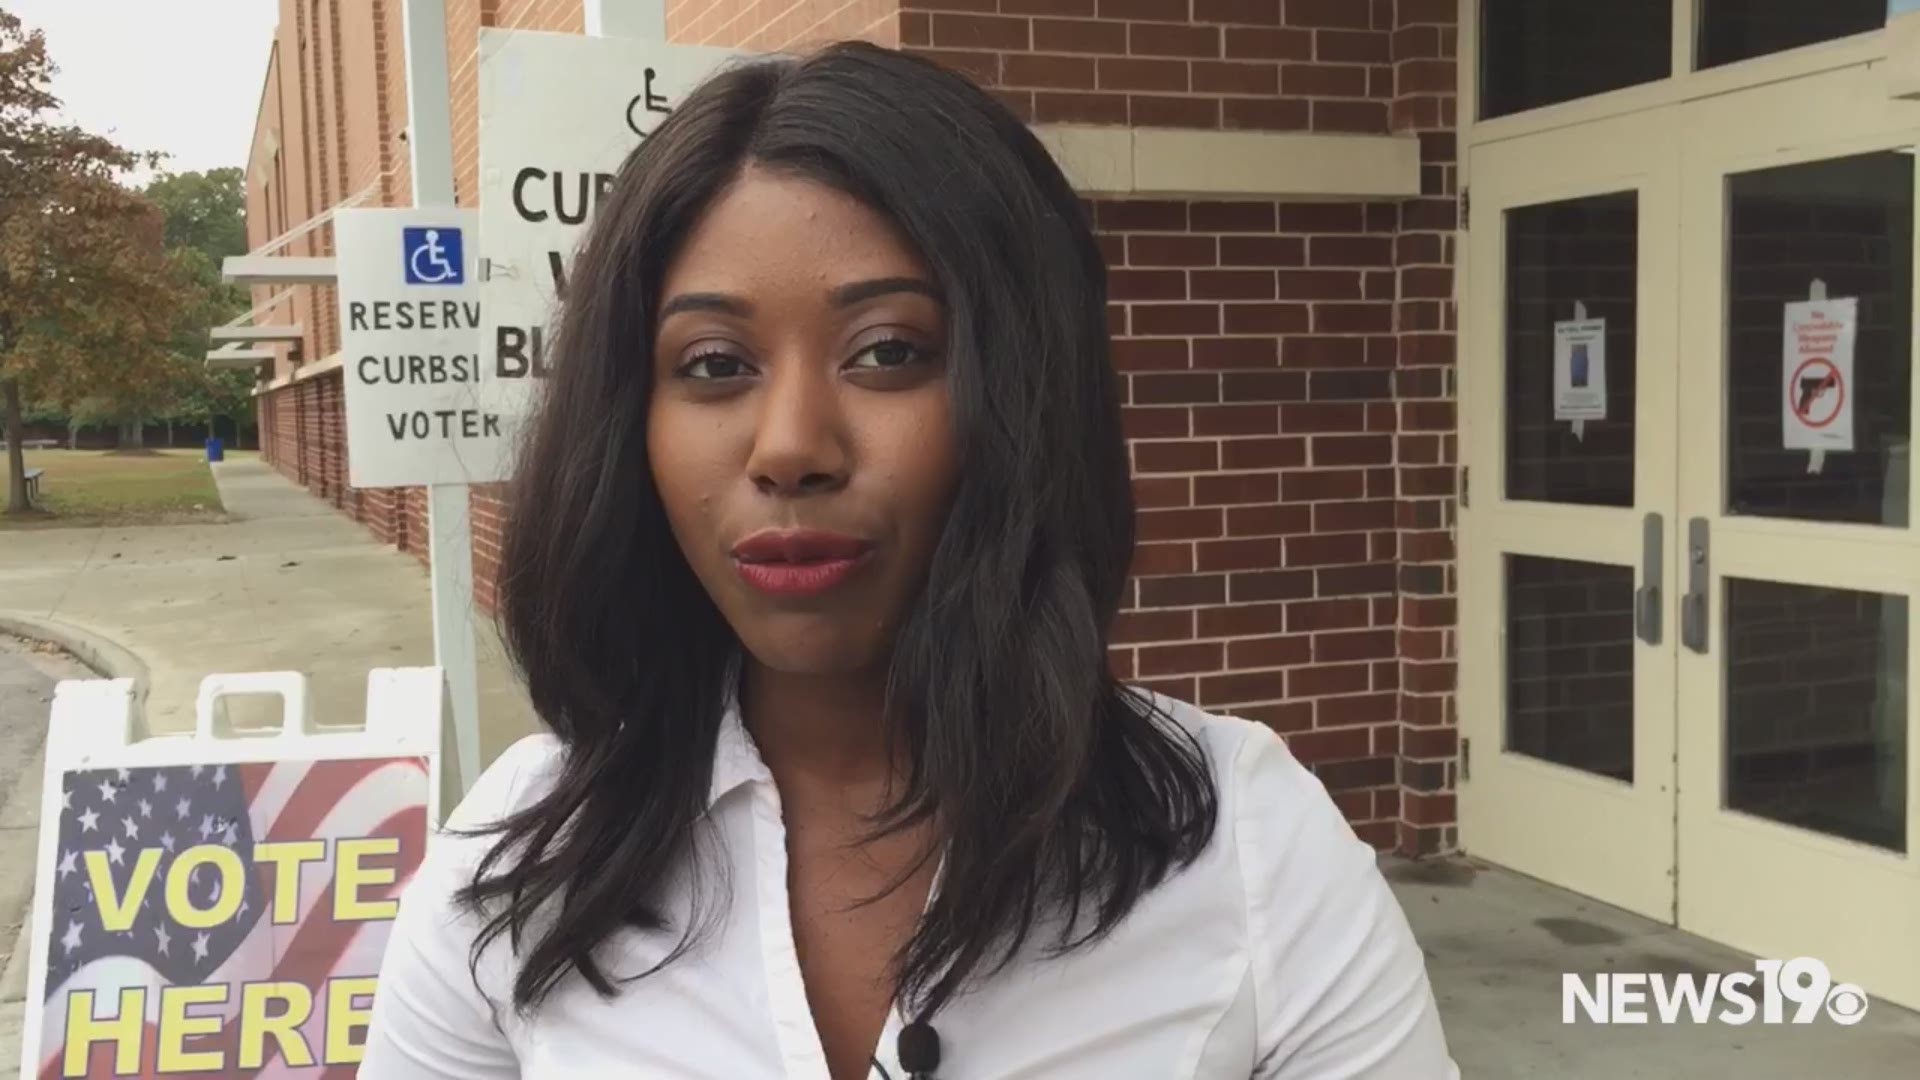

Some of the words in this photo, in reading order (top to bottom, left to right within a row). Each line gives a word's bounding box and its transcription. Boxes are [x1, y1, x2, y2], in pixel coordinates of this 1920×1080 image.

[349, 300, 480, 331] RESERV
[358, 354, 480, 385] CURBSI
[386, 410, 501, 441] VOTER
[84, 836, 400, 932] VOTE
[61, 975, 379, 1079] HERE
